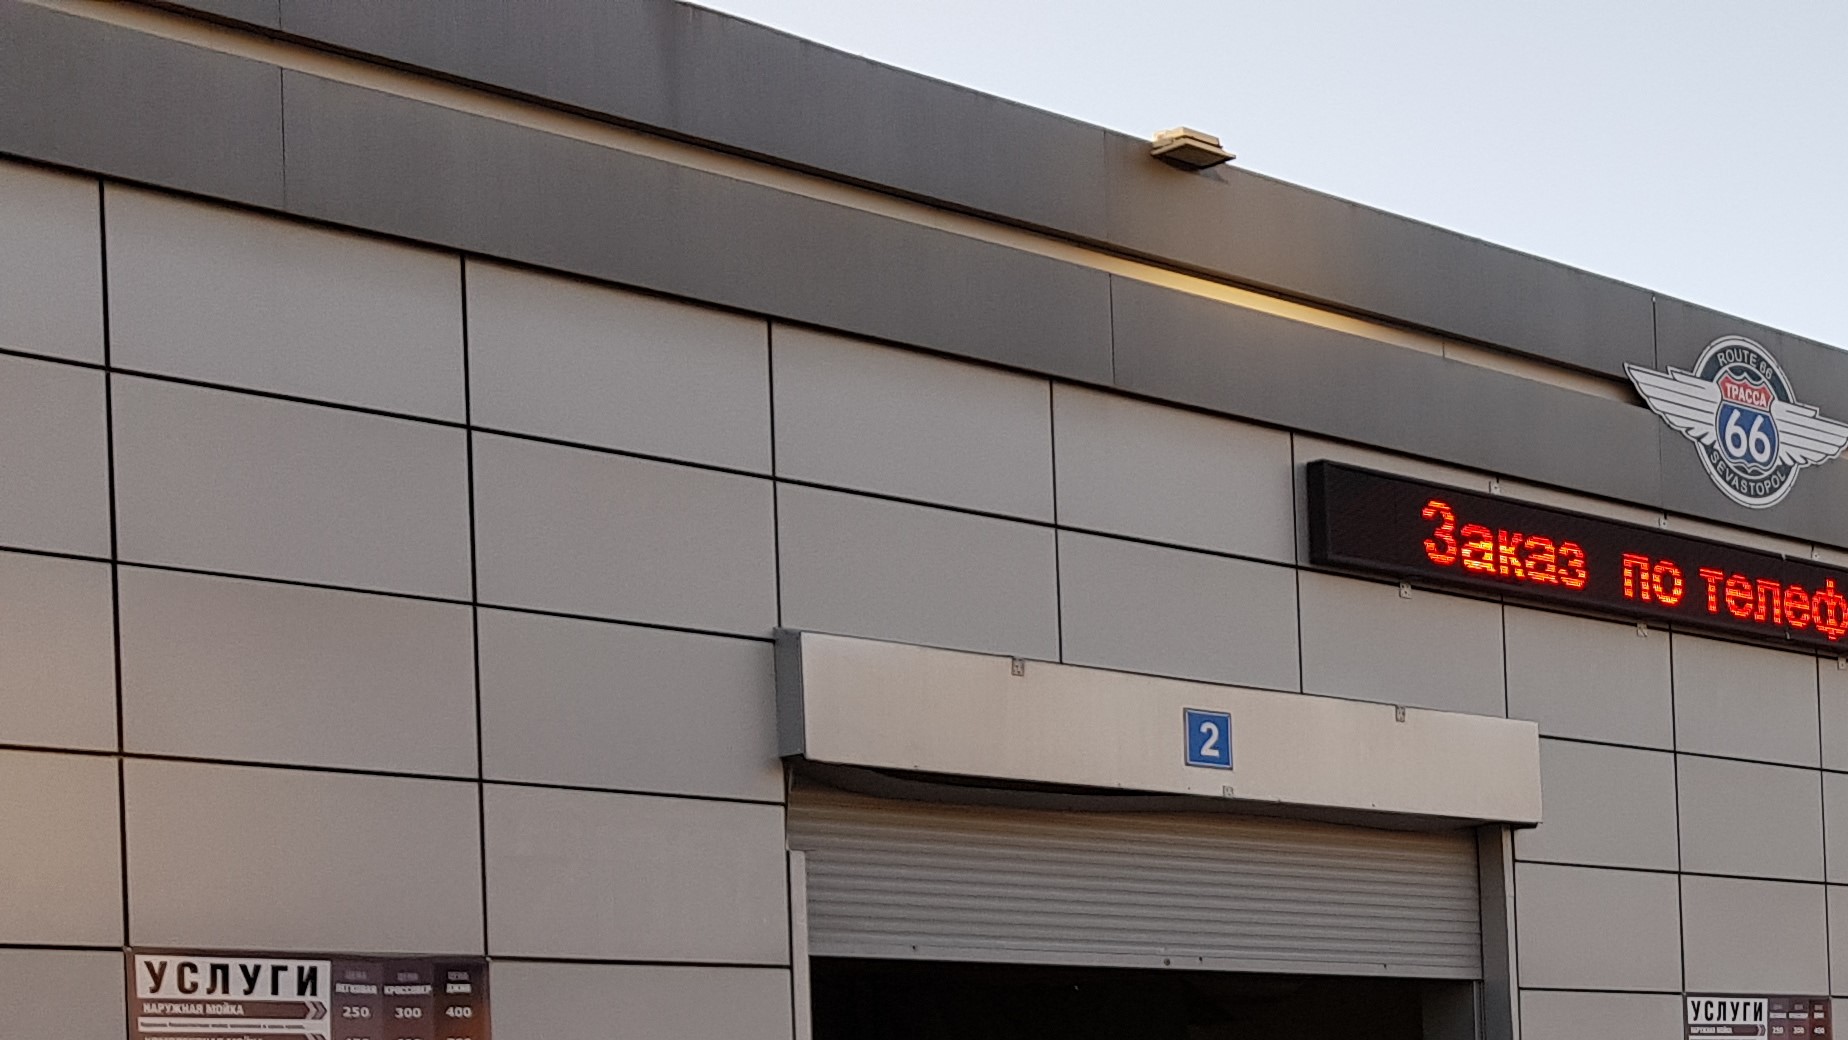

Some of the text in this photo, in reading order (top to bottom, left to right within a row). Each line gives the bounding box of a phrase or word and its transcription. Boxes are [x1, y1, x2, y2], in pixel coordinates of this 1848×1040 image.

[1717, 348, 1774, 380] ROUTE 66
[1725, 382, 1768, 408] ТРАССА
[1725, 408, 1771, 463] 66
[1711, 451, 1787, 497] SEVASTOPOL
[1421, 499, 1588, 591] Заказ
[1622, 552, 1684, 606] по
[1200, 721, 1219, 758] 2
[144, 960, 318, 997] УСЛУГИ
[143, 1002, 244, 1015] НАРУЖНАЯ МОЙКА
[342, 1006, 370, 1018] 250
[394, 1007, 422, 1018] 300
[445, 1006, 472, 1018] 400
[1691, 1000, 1763, 1021] УСЛУГИ
